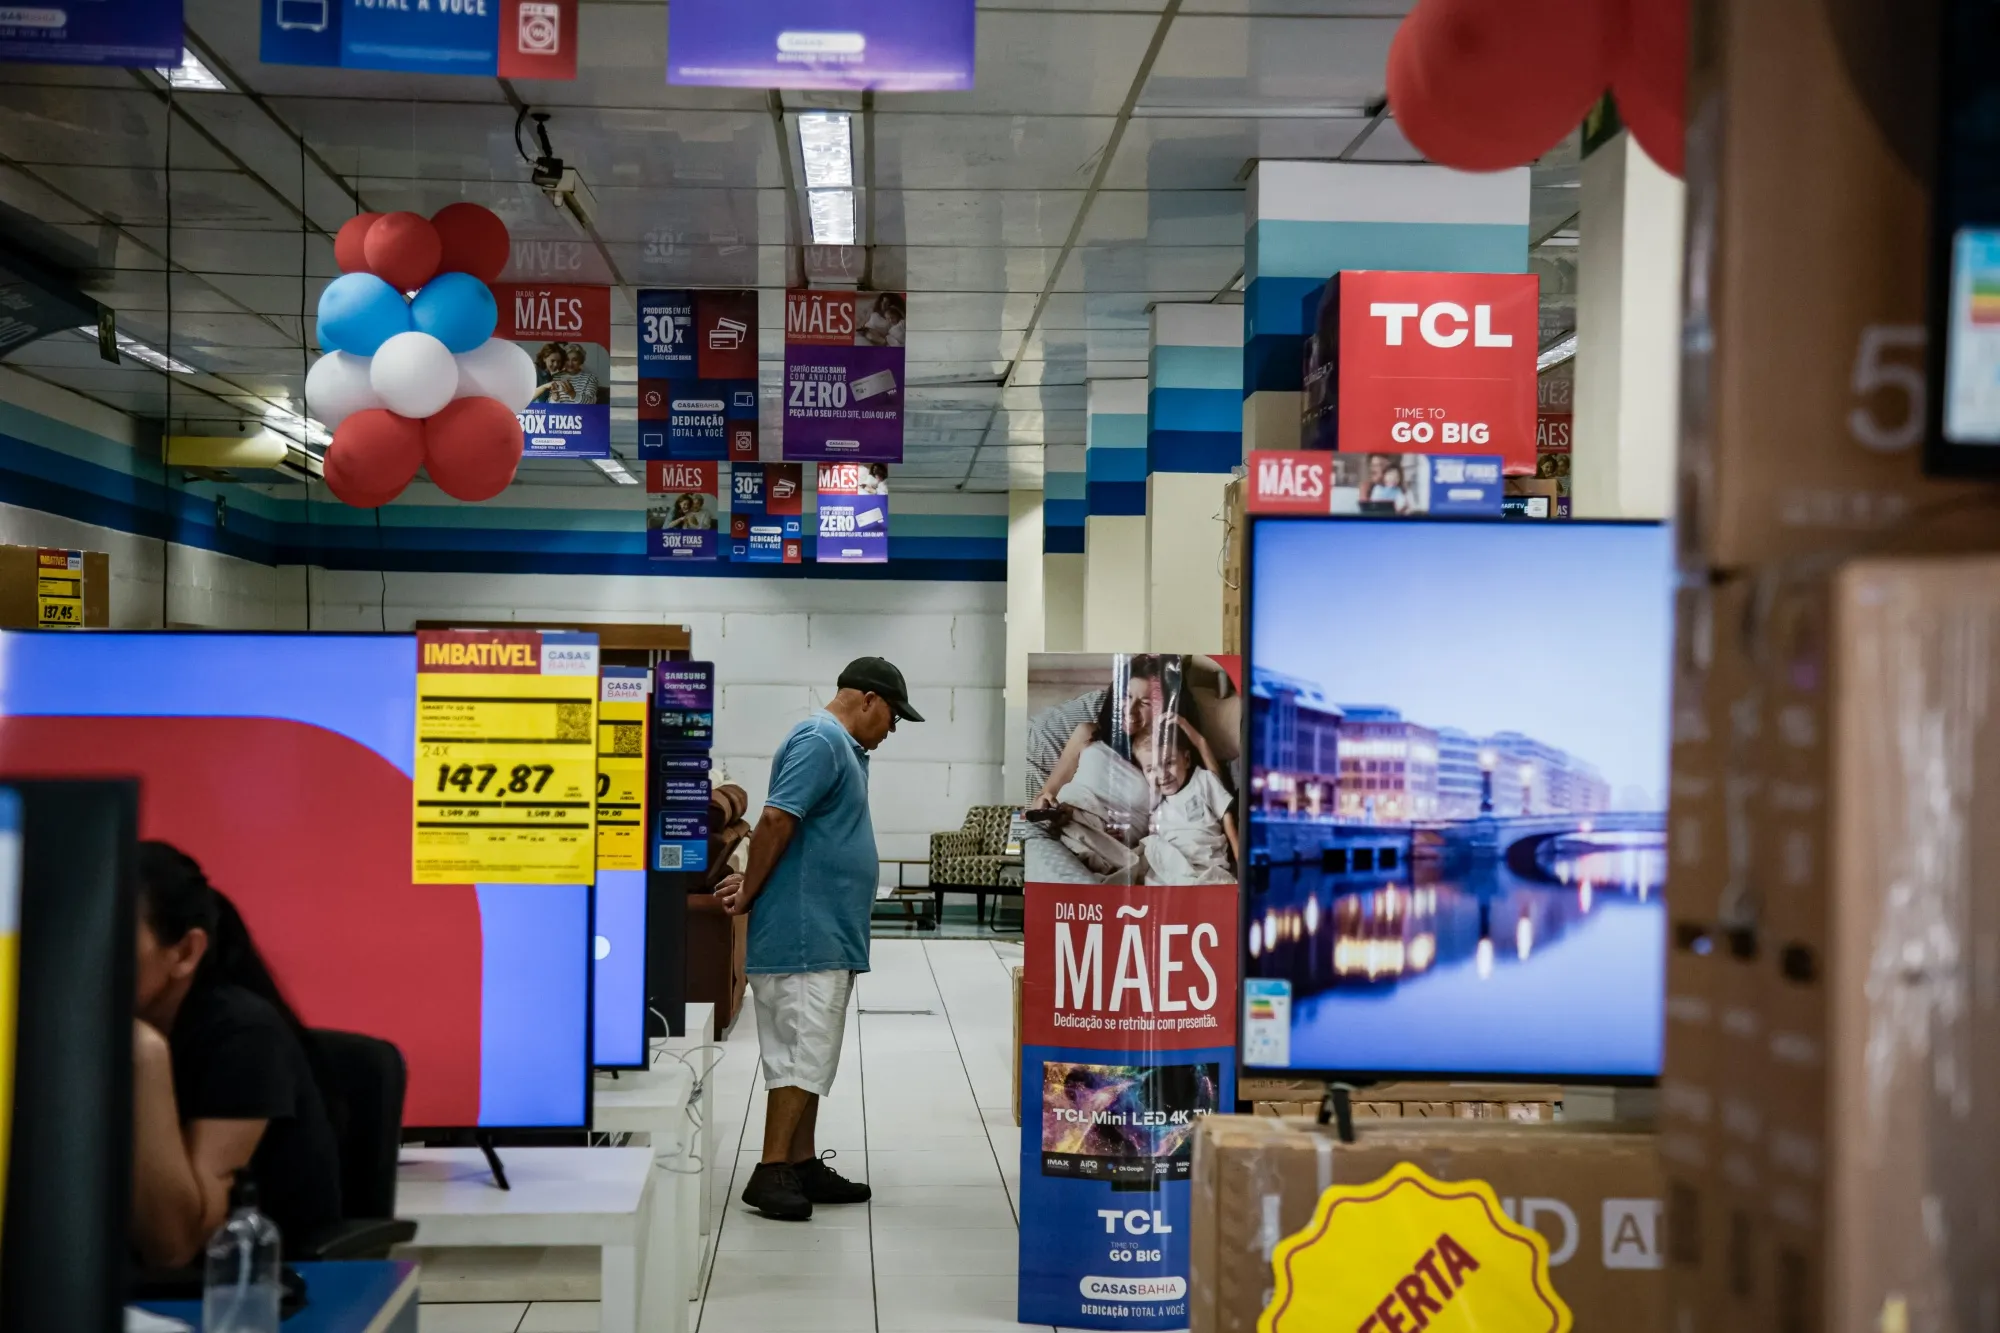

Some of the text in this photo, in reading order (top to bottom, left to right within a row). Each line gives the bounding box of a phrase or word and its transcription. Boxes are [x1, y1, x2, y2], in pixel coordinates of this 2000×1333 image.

[515, 291, 583, 331] MÃES
[642, 304, 691, 315] PRODUTOS EM ATÉ
[787, 295, 853, 334] MÃES
[1370, 301, 1513, 348] TCL
[652, 344, 673, 353] FIXAS
[789, 364, 847, 374] CARTÃO CASAS BAHIA
[789, 372, 847, 382] COM ANUIDADE
[788, 381, 848, 408] ZERO
[1849, 324, 1928, 454] 5
[671, 413, 725, 428] DEDICAÇÃO
[789, 408, 805, 418] PEÇA
[805, 408, 814, 417] JÁ
[819, 410, 832, 418] SEU
[832, 410, 847, 418] PELO
[847, 410, 861, 419] SITE,
[861, 410, 875, 419] LOJA
[875, 410, 884, 419] OU
[884, 411, 897, 419] APP.
[1394, 407, 1446, 419] TIME TO
[548, 415, 583, 430] FIXAS
[672, 428, 694, 437] TOTAL
[704, 427, 724, 437] VOCÊ
[1391, 421, 1490, 445] GO BIG
[662, 464, 703, 487] MÃES
[818, 465, 858, 488] MÃES
[1258, 458, 1324, 497] MÃES
[820, 515, 855, 532] ZERO
[662, 535, 703, 548] 30X FIXAS
[750, 534, 782, 543] DEDICAÇÃO
[43, 605, 73, 621] 137,45
[424, 638, 537, 667] IMBATÍVEL
[548, 651, 591, 660] CASAS
[548, 660, 587, 670] BAHIA
[664, 672, 706, 680] SAMSUNG
[607, 682, 642, 690] CASAS
[607, 689, 639, 698] BAHIA
[664, 683, 692, 691] Gaming
[437, 762, 555, 798] 147,87
[1055, 902, 1103, 921] DIA DAS
[1054, 904, 1219, 1012] MÃES
[1054, 1012, 1218, 1032] Dedicação se retribui com presentão.
[1052, 1107, 1089, 1124] TCL
[1091, 1109, 1127, 1126] Mini
[1132, 1111, 1167, 1126] LED
[1170, 1109, 1189, 1124] 4K
[1047, 1158, 1070, 1167] IMAX
[1097, 1209, 1172, 1235] TCL
[1110, 1241, 1127, 1249] TIME
[1109, 1249, 1161, 1262] GO BIG
[1090, 1282, 1177, 1295] CASASBAHIA
[1081, 1302, 1185, 1318] DEDICAÇÃO TOTAL A VOCÊ
